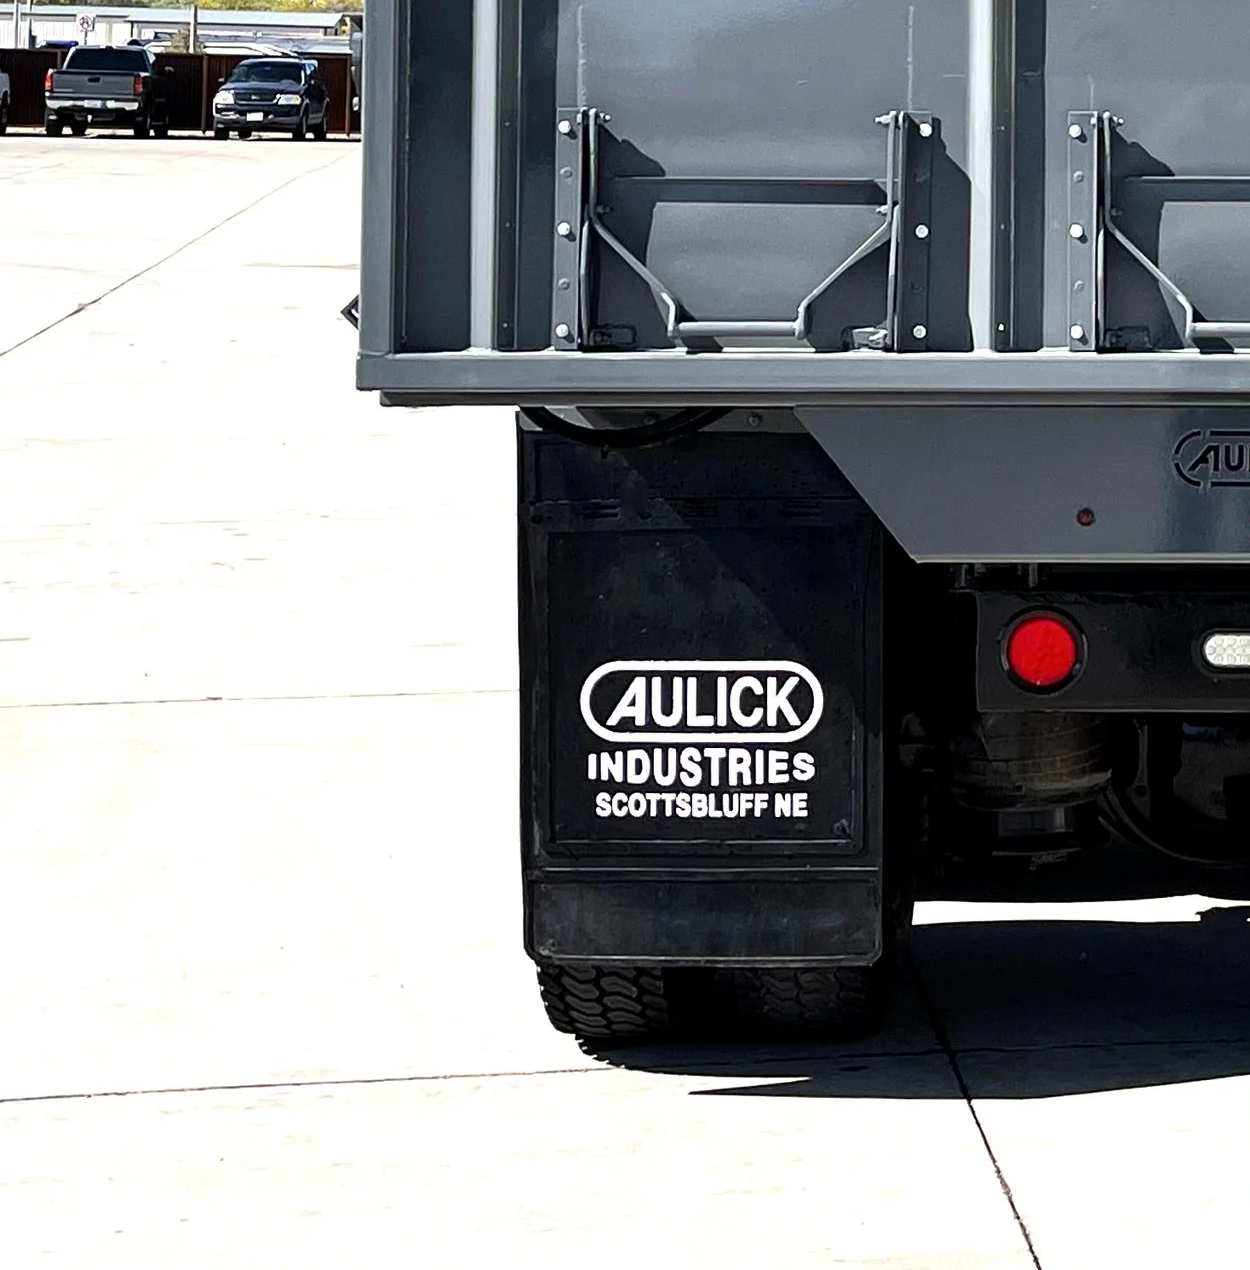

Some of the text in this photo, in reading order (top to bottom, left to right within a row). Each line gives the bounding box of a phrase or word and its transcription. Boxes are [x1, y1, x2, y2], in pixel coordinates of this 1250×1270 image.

[605, 676, 801, 727] AULICK
[587, 747, 816, 787] INDUSTRIES
[595, 792, 808, 818] SCOTTSBLUFF NE
